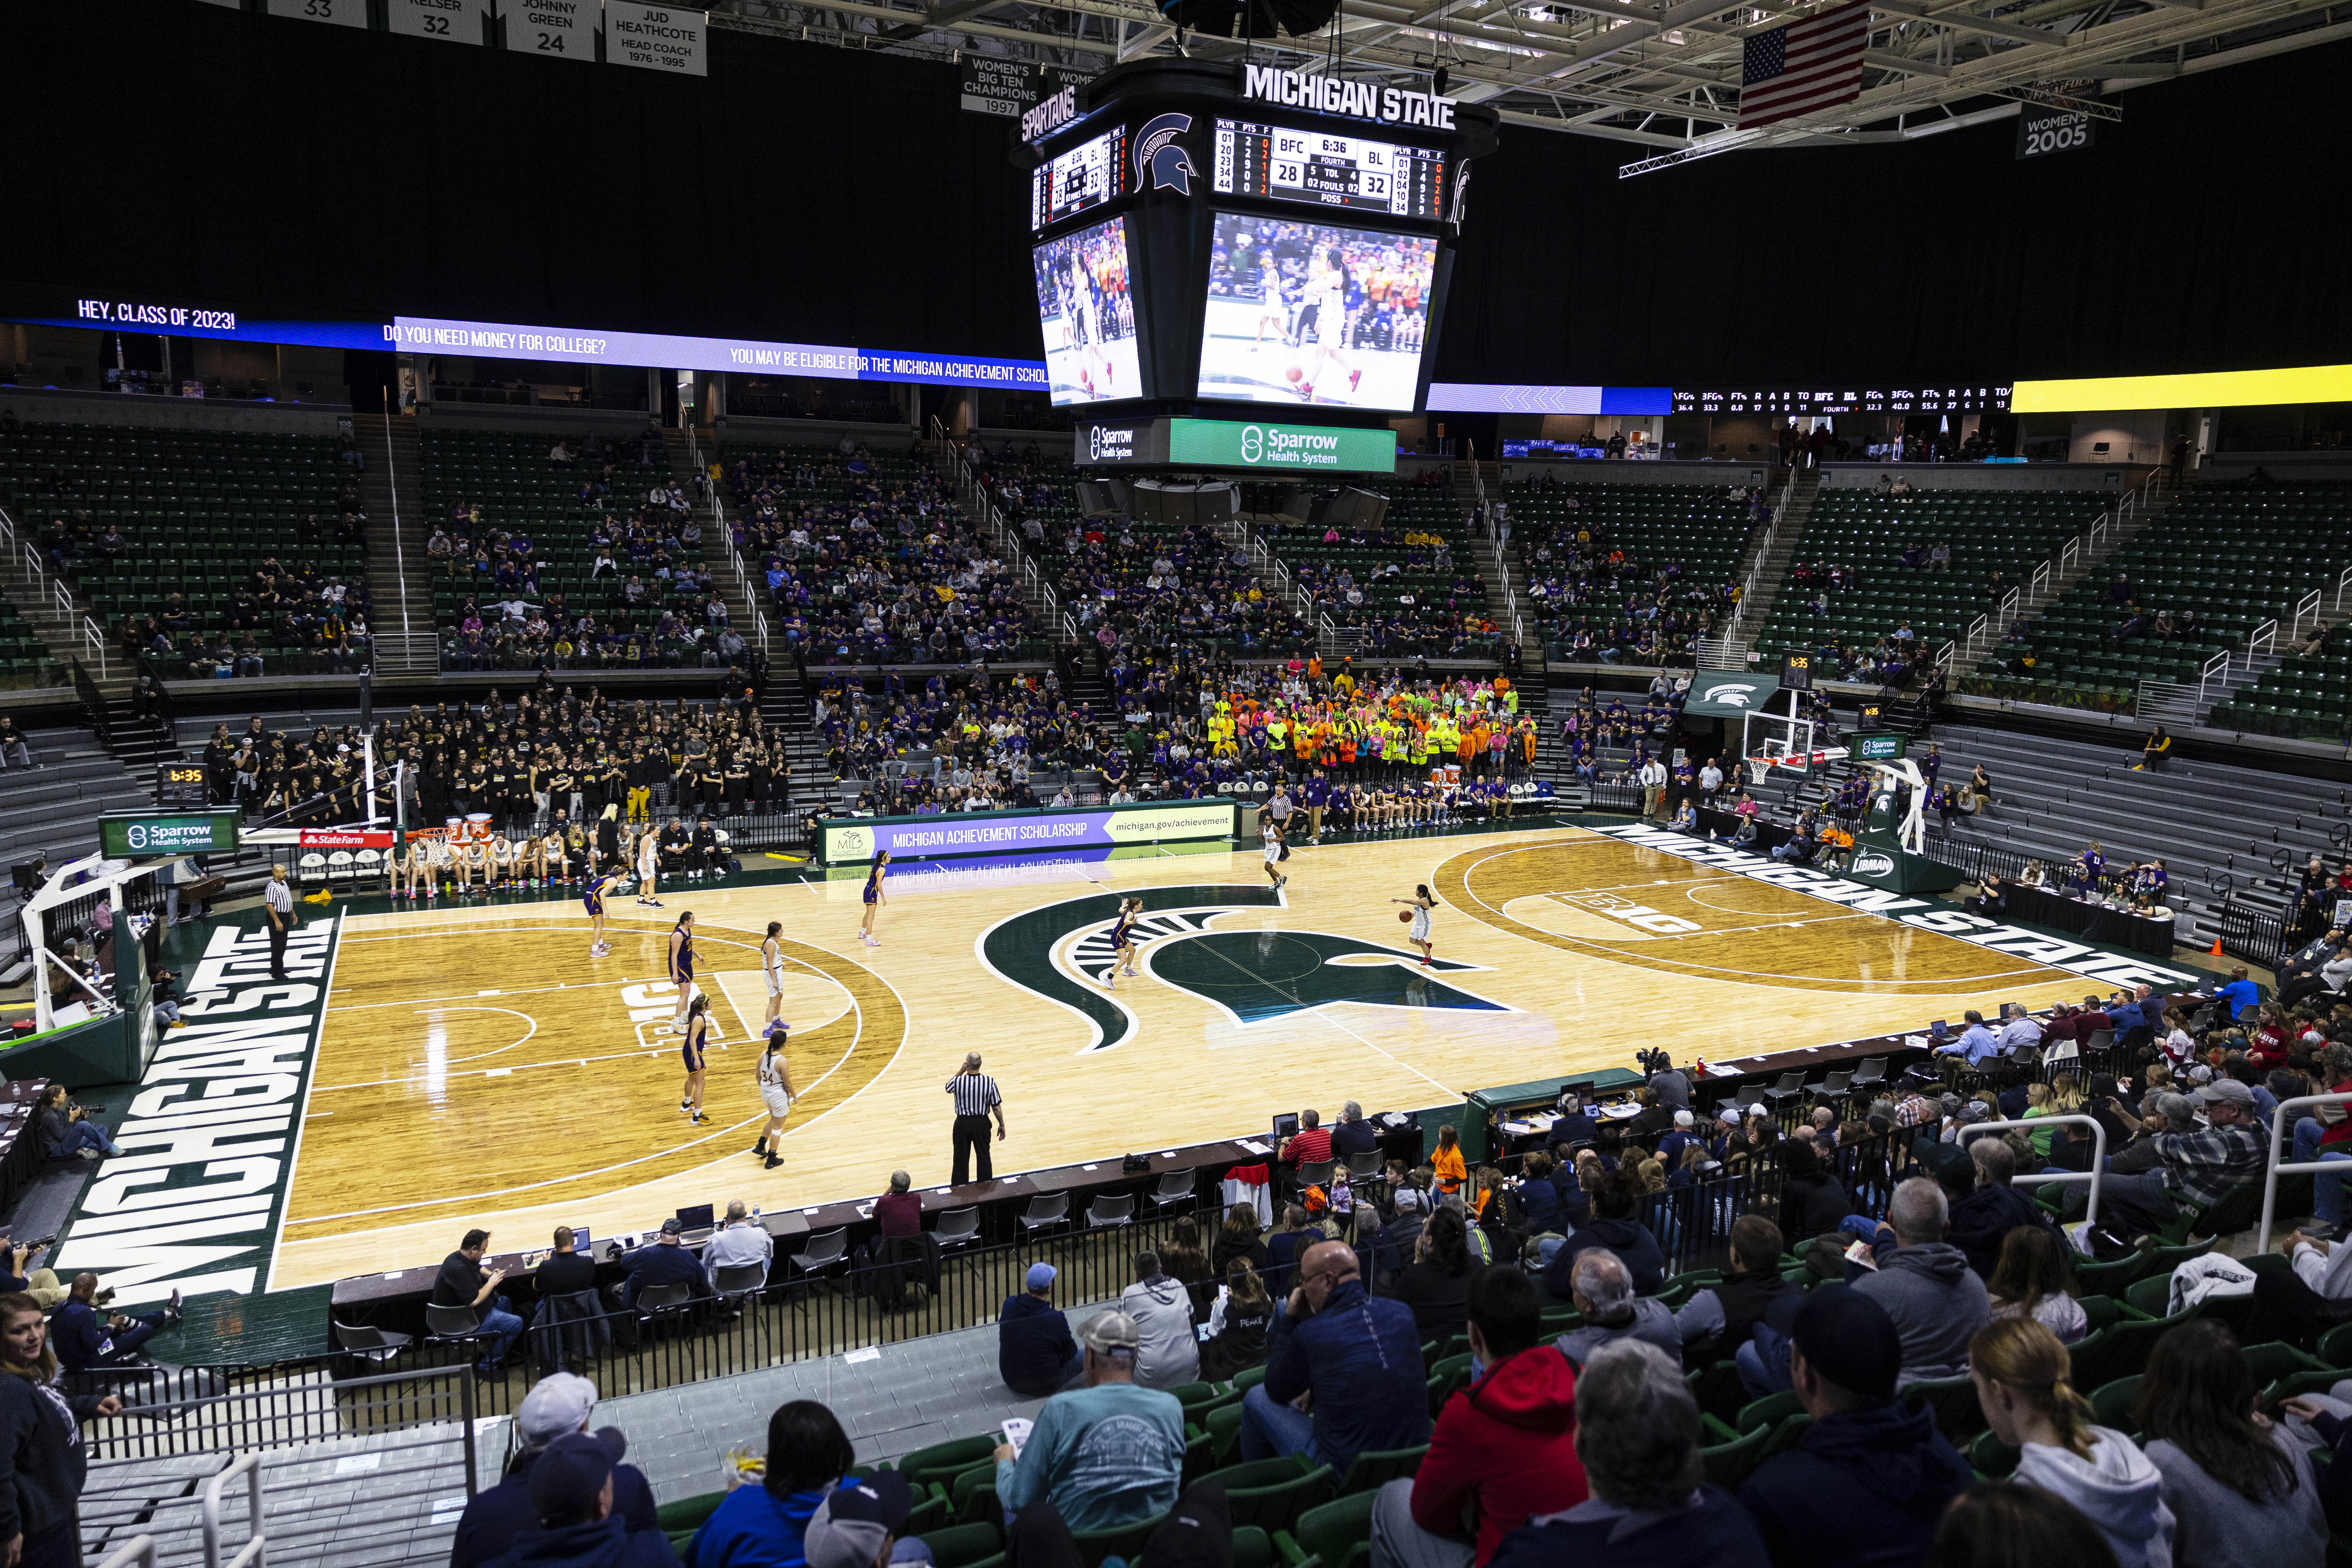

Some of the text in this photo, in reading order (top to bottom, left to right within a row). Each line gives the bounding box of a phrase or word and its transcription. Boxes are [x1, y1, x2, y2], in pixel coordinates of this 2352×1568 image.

[522, 0, 577, 14] JOHNNY
[528, 13, 573, 28] GREEN
[643, 10, 669, 23] JUD
[423, 15, 450, 35] 32
[616, 20, 696, 42] HEATHCOTE
[537, 32, 565, 52] 24
[622, 39, 692, 56] HEAD COACH
[629, 51, 652, 63] 1976
[662, 56, 685, 67] 1995
[972, 58, 1029, 76] WOMEN'S
[978, 72, 1023, 88] BIG TEN
[1058, 71, 1097, 85] WOME
[964, 82, 1037, 101] CHAMPIONS
[1244, 64, 1458, 130] MICHIGAN STATE
[985, 100, 1015, 114] 1997
[1022, 85, 1075, 142] SPARTANS
[1217, 120, 1235, 130] PLYR
[1243, 124, 1256, 133] PTS
[2028, 111, 2089, 132] WOMEN'S
[1222, 133, 1231, 142] 01
[2025, 124, 2087, 155] 2005
[1221, 145, 1231, 155] 20
[1281, 139, 1303, 153] BFC
[1323, 139, 1346, 153] 6:36
[1395, 146, 1411, 155] PLYR
[1418, 150, 1430, 159] PTS
[1221, 157, 1230, 166] 23
[1321, 156, 1345, 166] FOURTH
[1369, 152, 1383, 165] BL
[1399, 159, 1407, 168] 01
[1220, 167, 1230, 177] 34
[1279, 164, 1297, 181] 28
[1310, 166, 1356, 180] 5 TOL 4
[1398, 170, 1407, 179] 02
[1091, 172, 1098, 190] 32
[1219, 179, 1230, 189] 44
[1308, 178, 1358, 193] 02 FOULS 02
[1368, 176, 1384, 193] 32
[1397, 181, 1407, 190] 04
[1055, 189, 1063, 204] 28
[1321, 193, 1342, 203] POSS
[1397, 192, 1406, 200] 10
[1396, 203, 1405, 211] 34
[78, 299, 236, 330] HEY, CLASS OF 2023!
[384, 324, 607, 355] DO YOU NEED MONEY FOR COLLEGE?
[730, 348, 1049, 384] YOU MAY BE ELIGIBLE FOR THE MICHIGAN ACHIEVEMENT SCHOL
[1814, 392, 1833, 401] BFC
[1844, 392, 1857, 401] BL
[1866, 391, 1883, 399] FG%
[1891, 390, 1914, 399] 3FG%
[1102, 427, 1133, 448] Sparrow
[1268, 429, 1338, 452] Sparrow
[1101, 447, 1132, 460] Health System
[1267, 450, 1337, 465] Health System
[1791, 657, 1808, 668] 6:35
[1871, 741, 1896, 750] Sparrow
[171, 769, 202, 781] 6:35
[1116, 817, 1229, 831] michigan.gov/achievement
[150, 825, 211, 840] Sparrow
[893, 822, 1087, 848] MICHIGAN ACHIEVEMENT SCHOLARSHIP
[182, 837, 212, 846] System
[1852, 858, 1892, 873] LIBMAN
[1584, 823, 2200, 990] MICHIGAN STATE
[2257, 1032, 2279, 1046] RATES
[761, 1069, 774, 1085] 34
[52, 918, 334, 1309] MICHIGAN STATE
[1240, 1316, 1263, 1328] PEAKE
